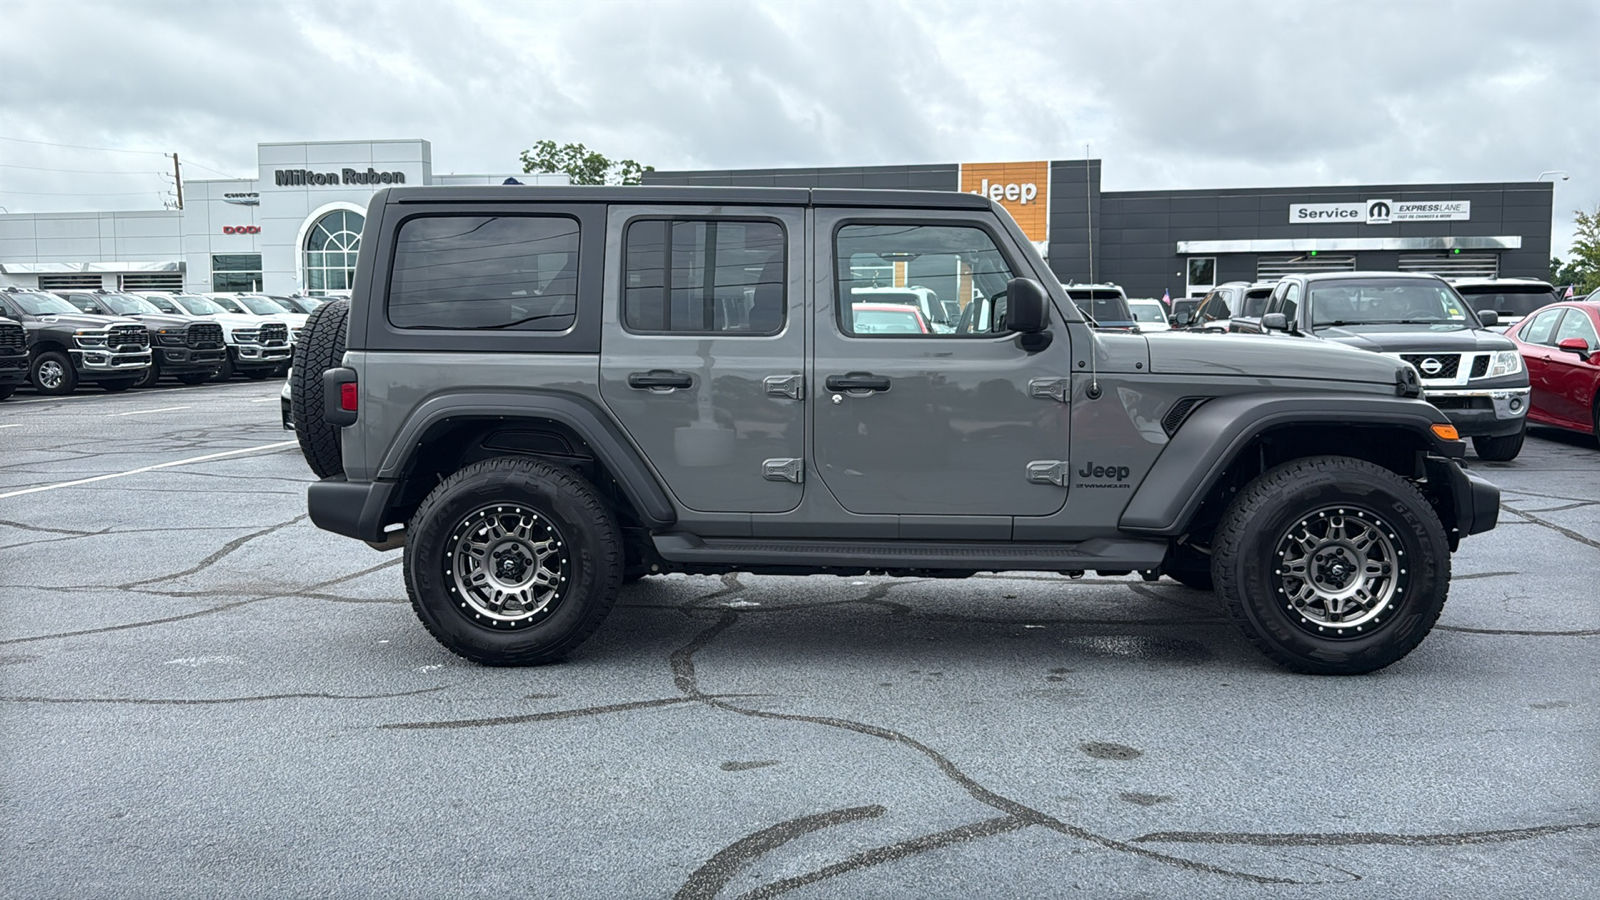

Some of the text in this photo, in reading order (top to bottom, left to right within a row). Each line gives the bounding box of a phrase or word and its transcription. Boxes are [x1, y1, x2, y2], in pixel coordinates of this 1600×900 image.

[275, 168, 405, 186] Milton Ruben
[971, 179, 1037, 205] Jeep
[1298, 208, 1358, 219] Service
[1079, 462, 1130, 481] Jeep
